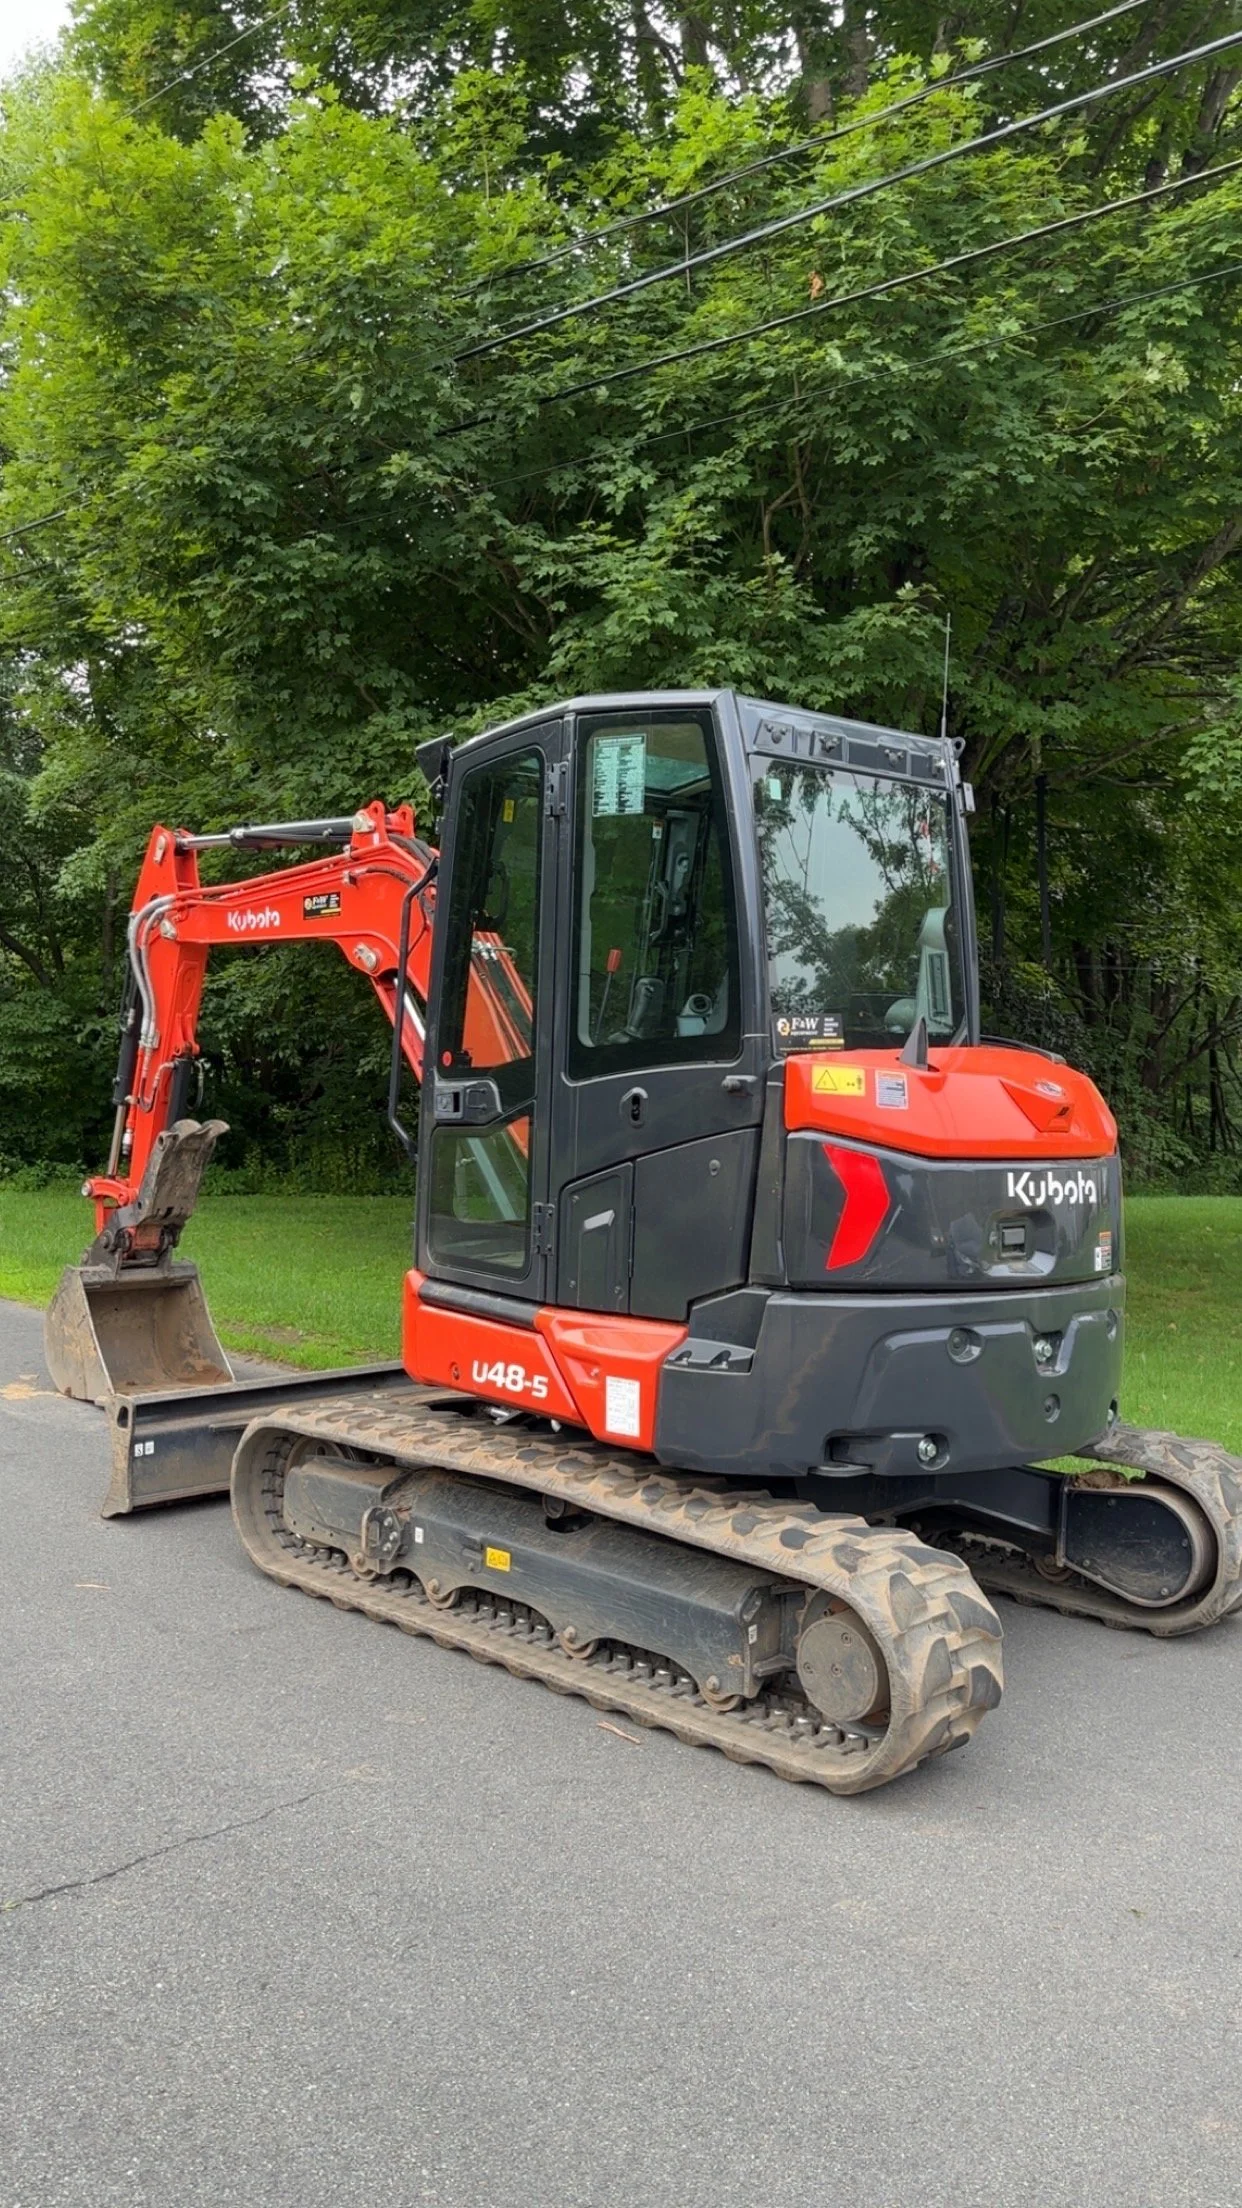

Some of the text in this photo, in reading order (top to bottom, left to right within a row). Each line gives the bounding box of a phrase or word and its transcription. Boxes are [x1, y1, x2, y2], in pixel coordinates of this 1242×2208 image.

[227, 905, 280, 932] Kubota
[1007, 1171, 1097, 1206] Kubota
[472, 1360, 549, 1398] U48-5
